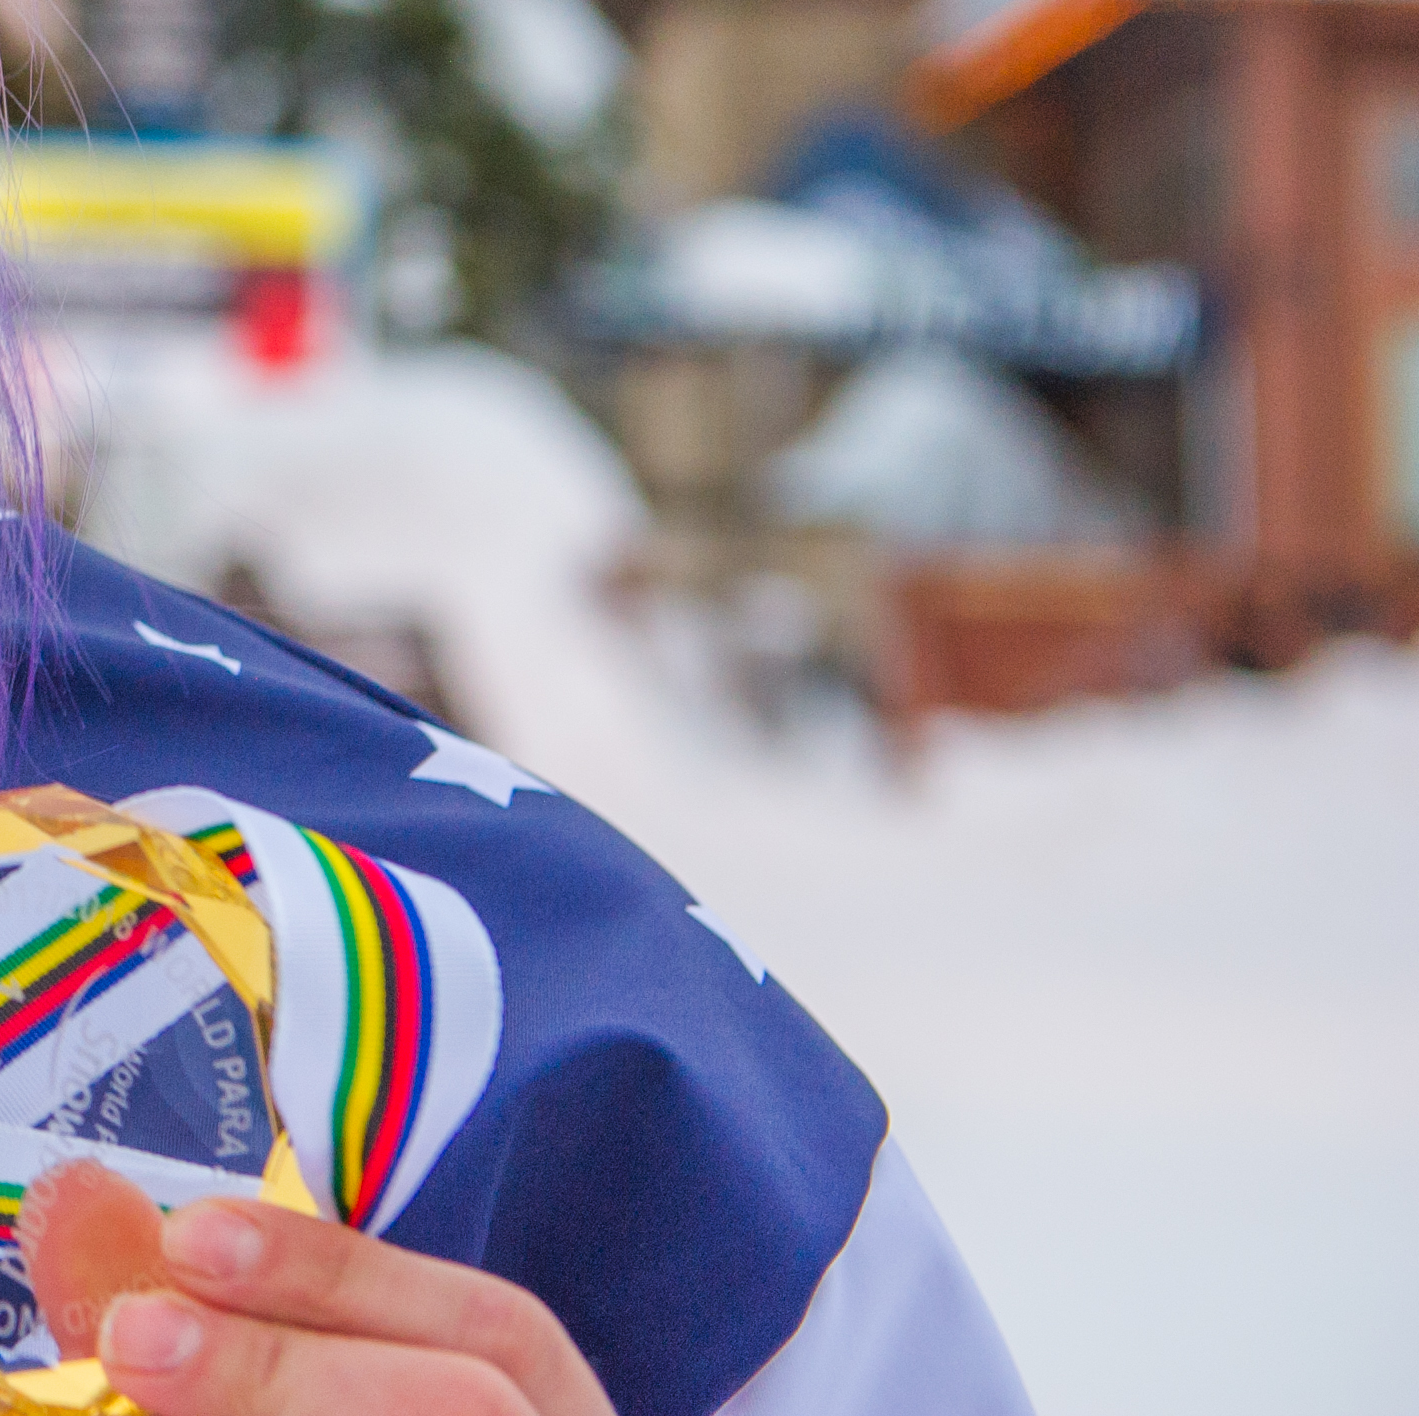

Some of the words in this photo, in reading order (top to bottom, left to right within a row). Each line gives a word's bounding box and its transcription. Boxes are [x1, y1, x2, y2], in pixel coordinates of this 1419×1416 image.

[98, 1036, 148, 1126] World
[139, 926, 242, 1058] WORLD
[213, 1054, 254, 1161] PARA
